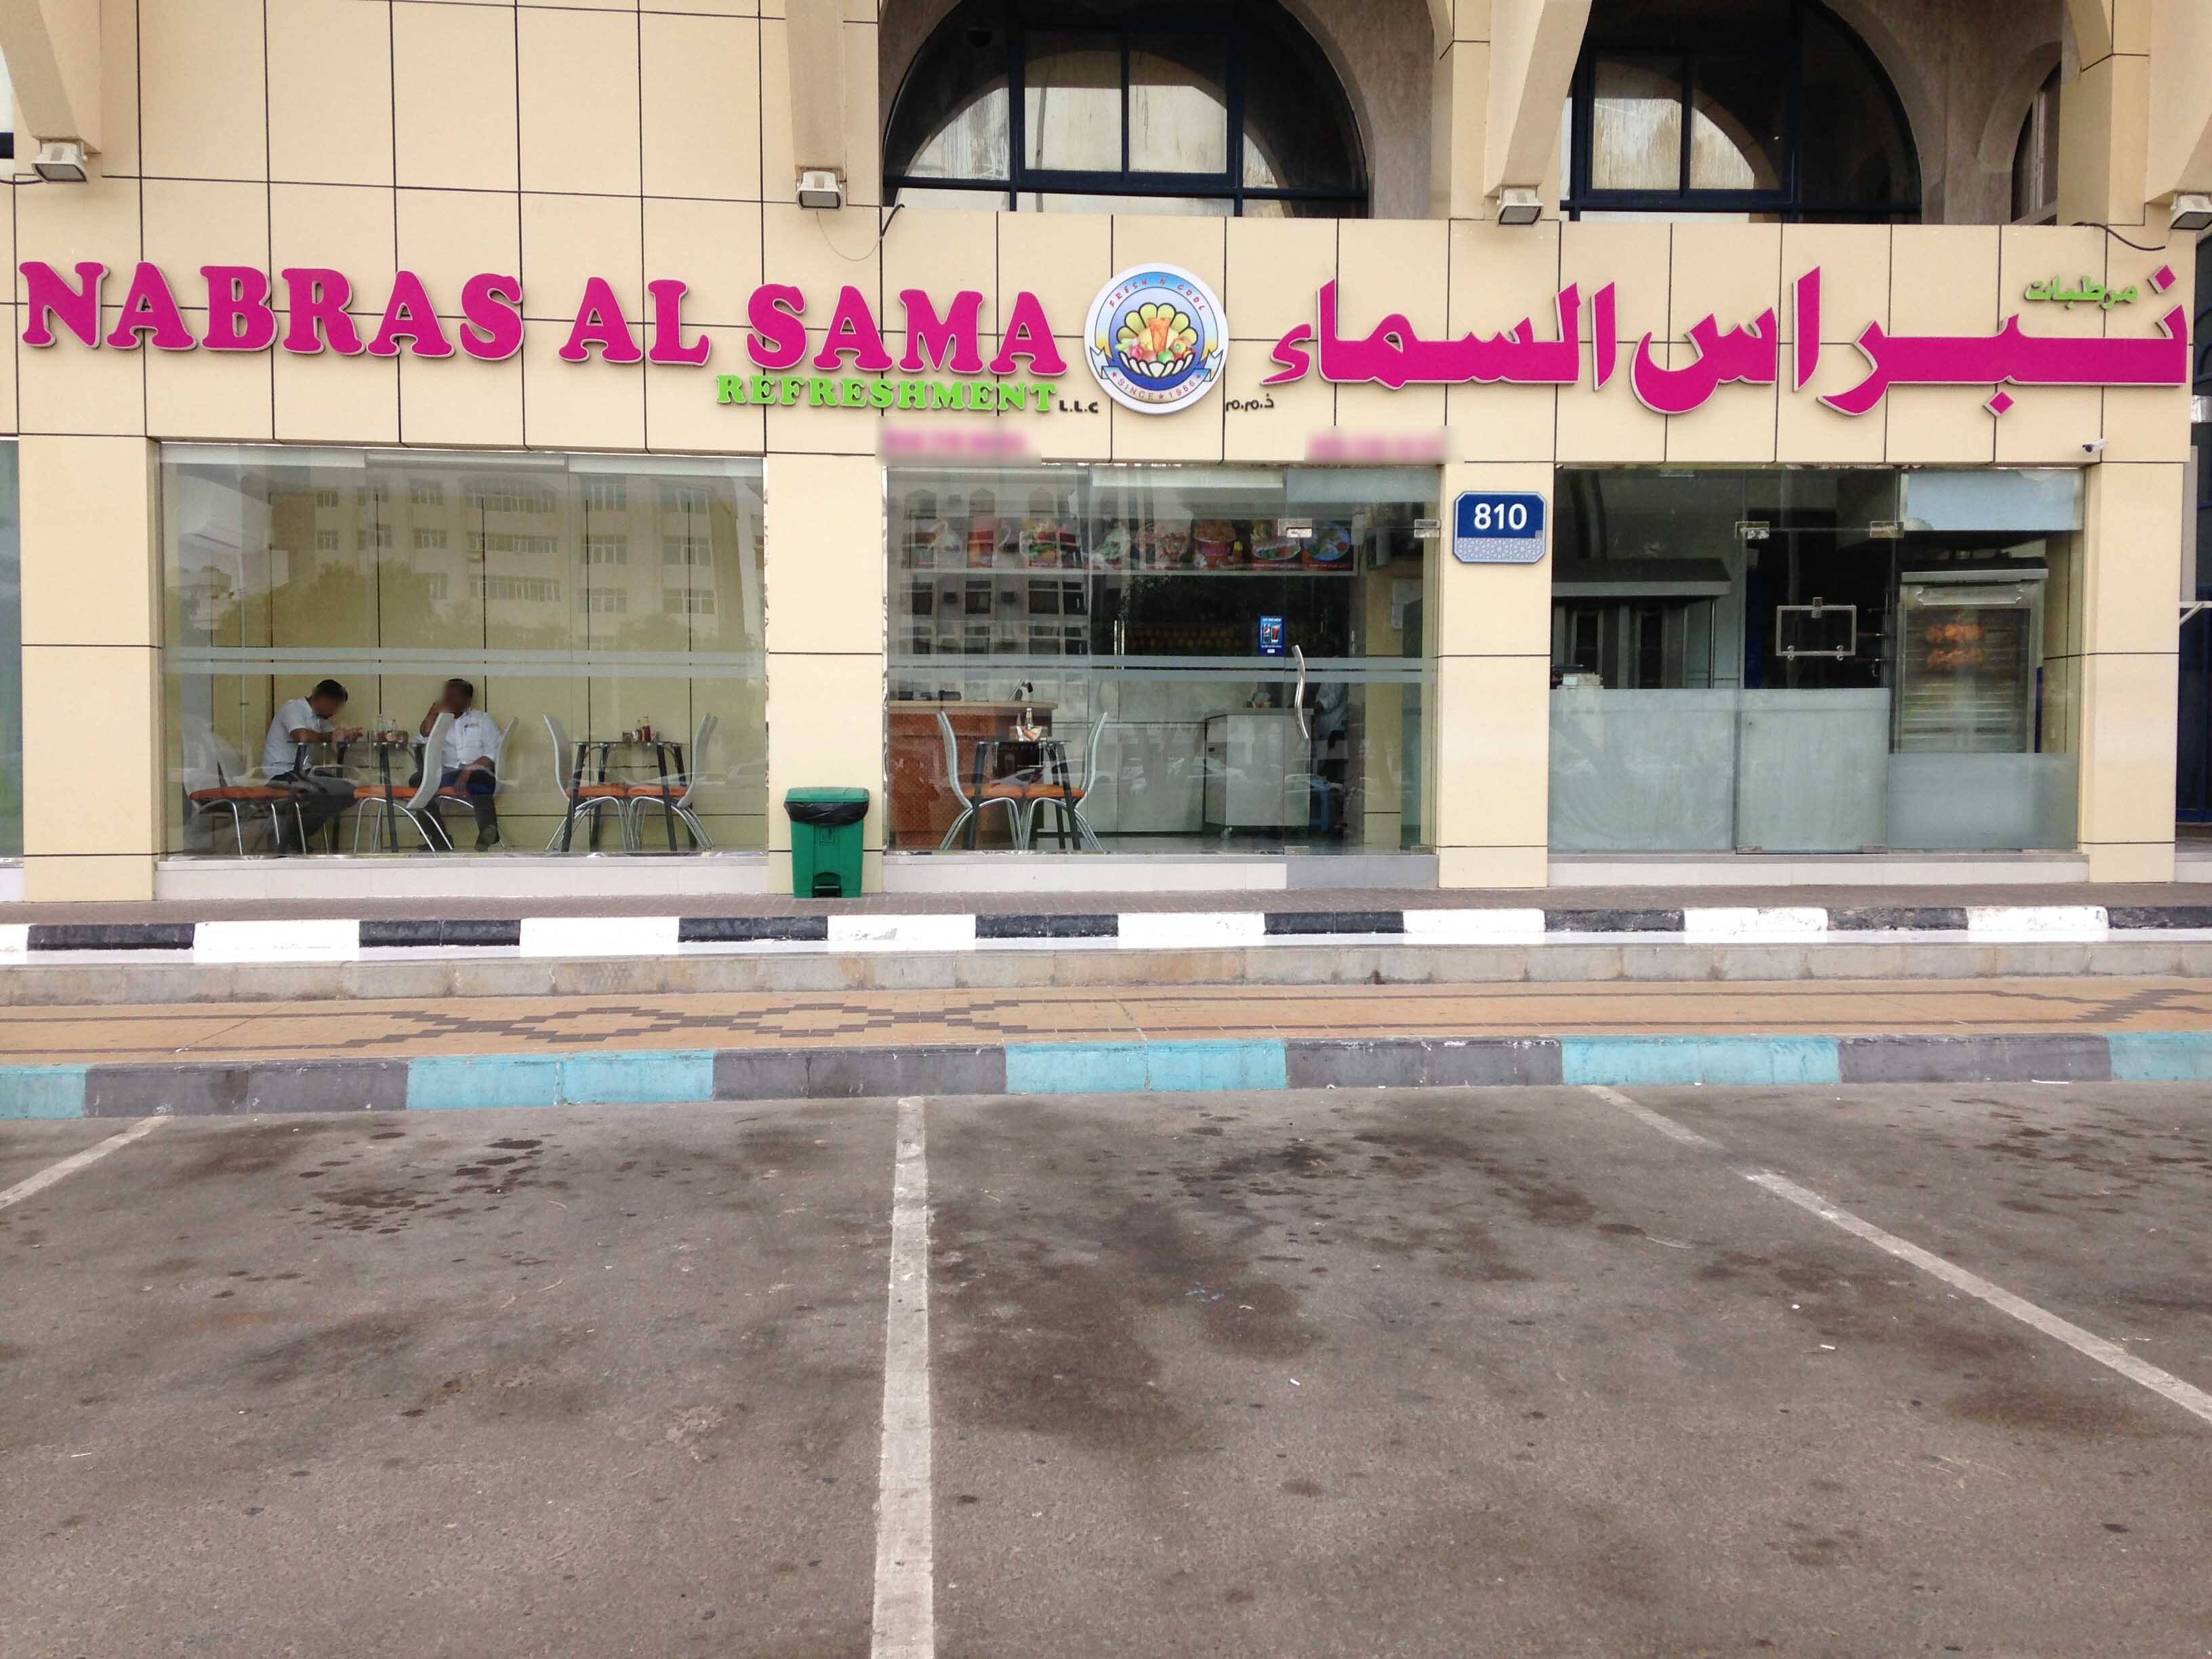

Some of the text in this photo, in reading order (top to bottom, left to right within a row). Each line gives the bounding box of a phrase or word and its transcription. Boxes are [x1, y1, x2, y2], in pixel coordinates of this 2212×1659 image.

[1109, 279, 1147, 308] FRESH
[1177, 284, 1205, 310] COOL
[2026, 275, 2139, 310] مرطبات
[18, 261, 1067, 375] NABRAS AL SAMA
[1263, 265, 2189, 415] نبراس السماء
[716, 374, 1099, 414] REFRESHMENT L.L.C
[1118, 379, 1153, 400] SINCE
[1474, 503, 1528, 530] 810
